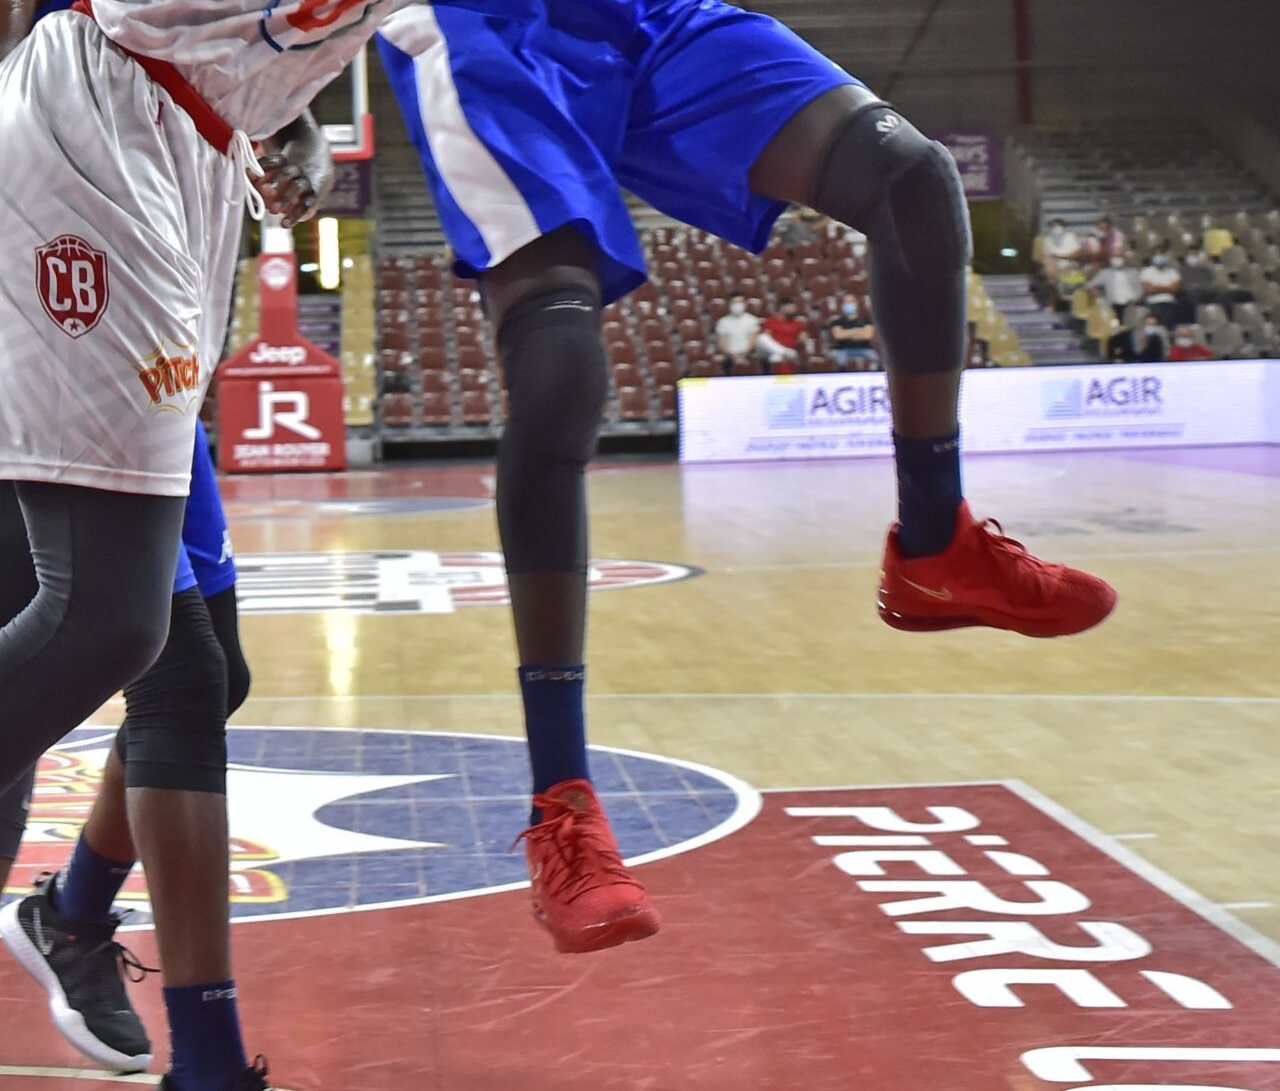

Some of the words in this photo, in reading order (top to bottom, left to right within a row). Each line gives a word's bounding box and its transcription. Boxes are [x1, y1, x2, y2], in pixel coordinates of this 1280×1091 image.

[47, 257, 98, 314] CB
[249, 342, 308, 366] Jeep
[811, 386, 888, 415] AGIR
[1086, 376, 1163, 406] AGIR
